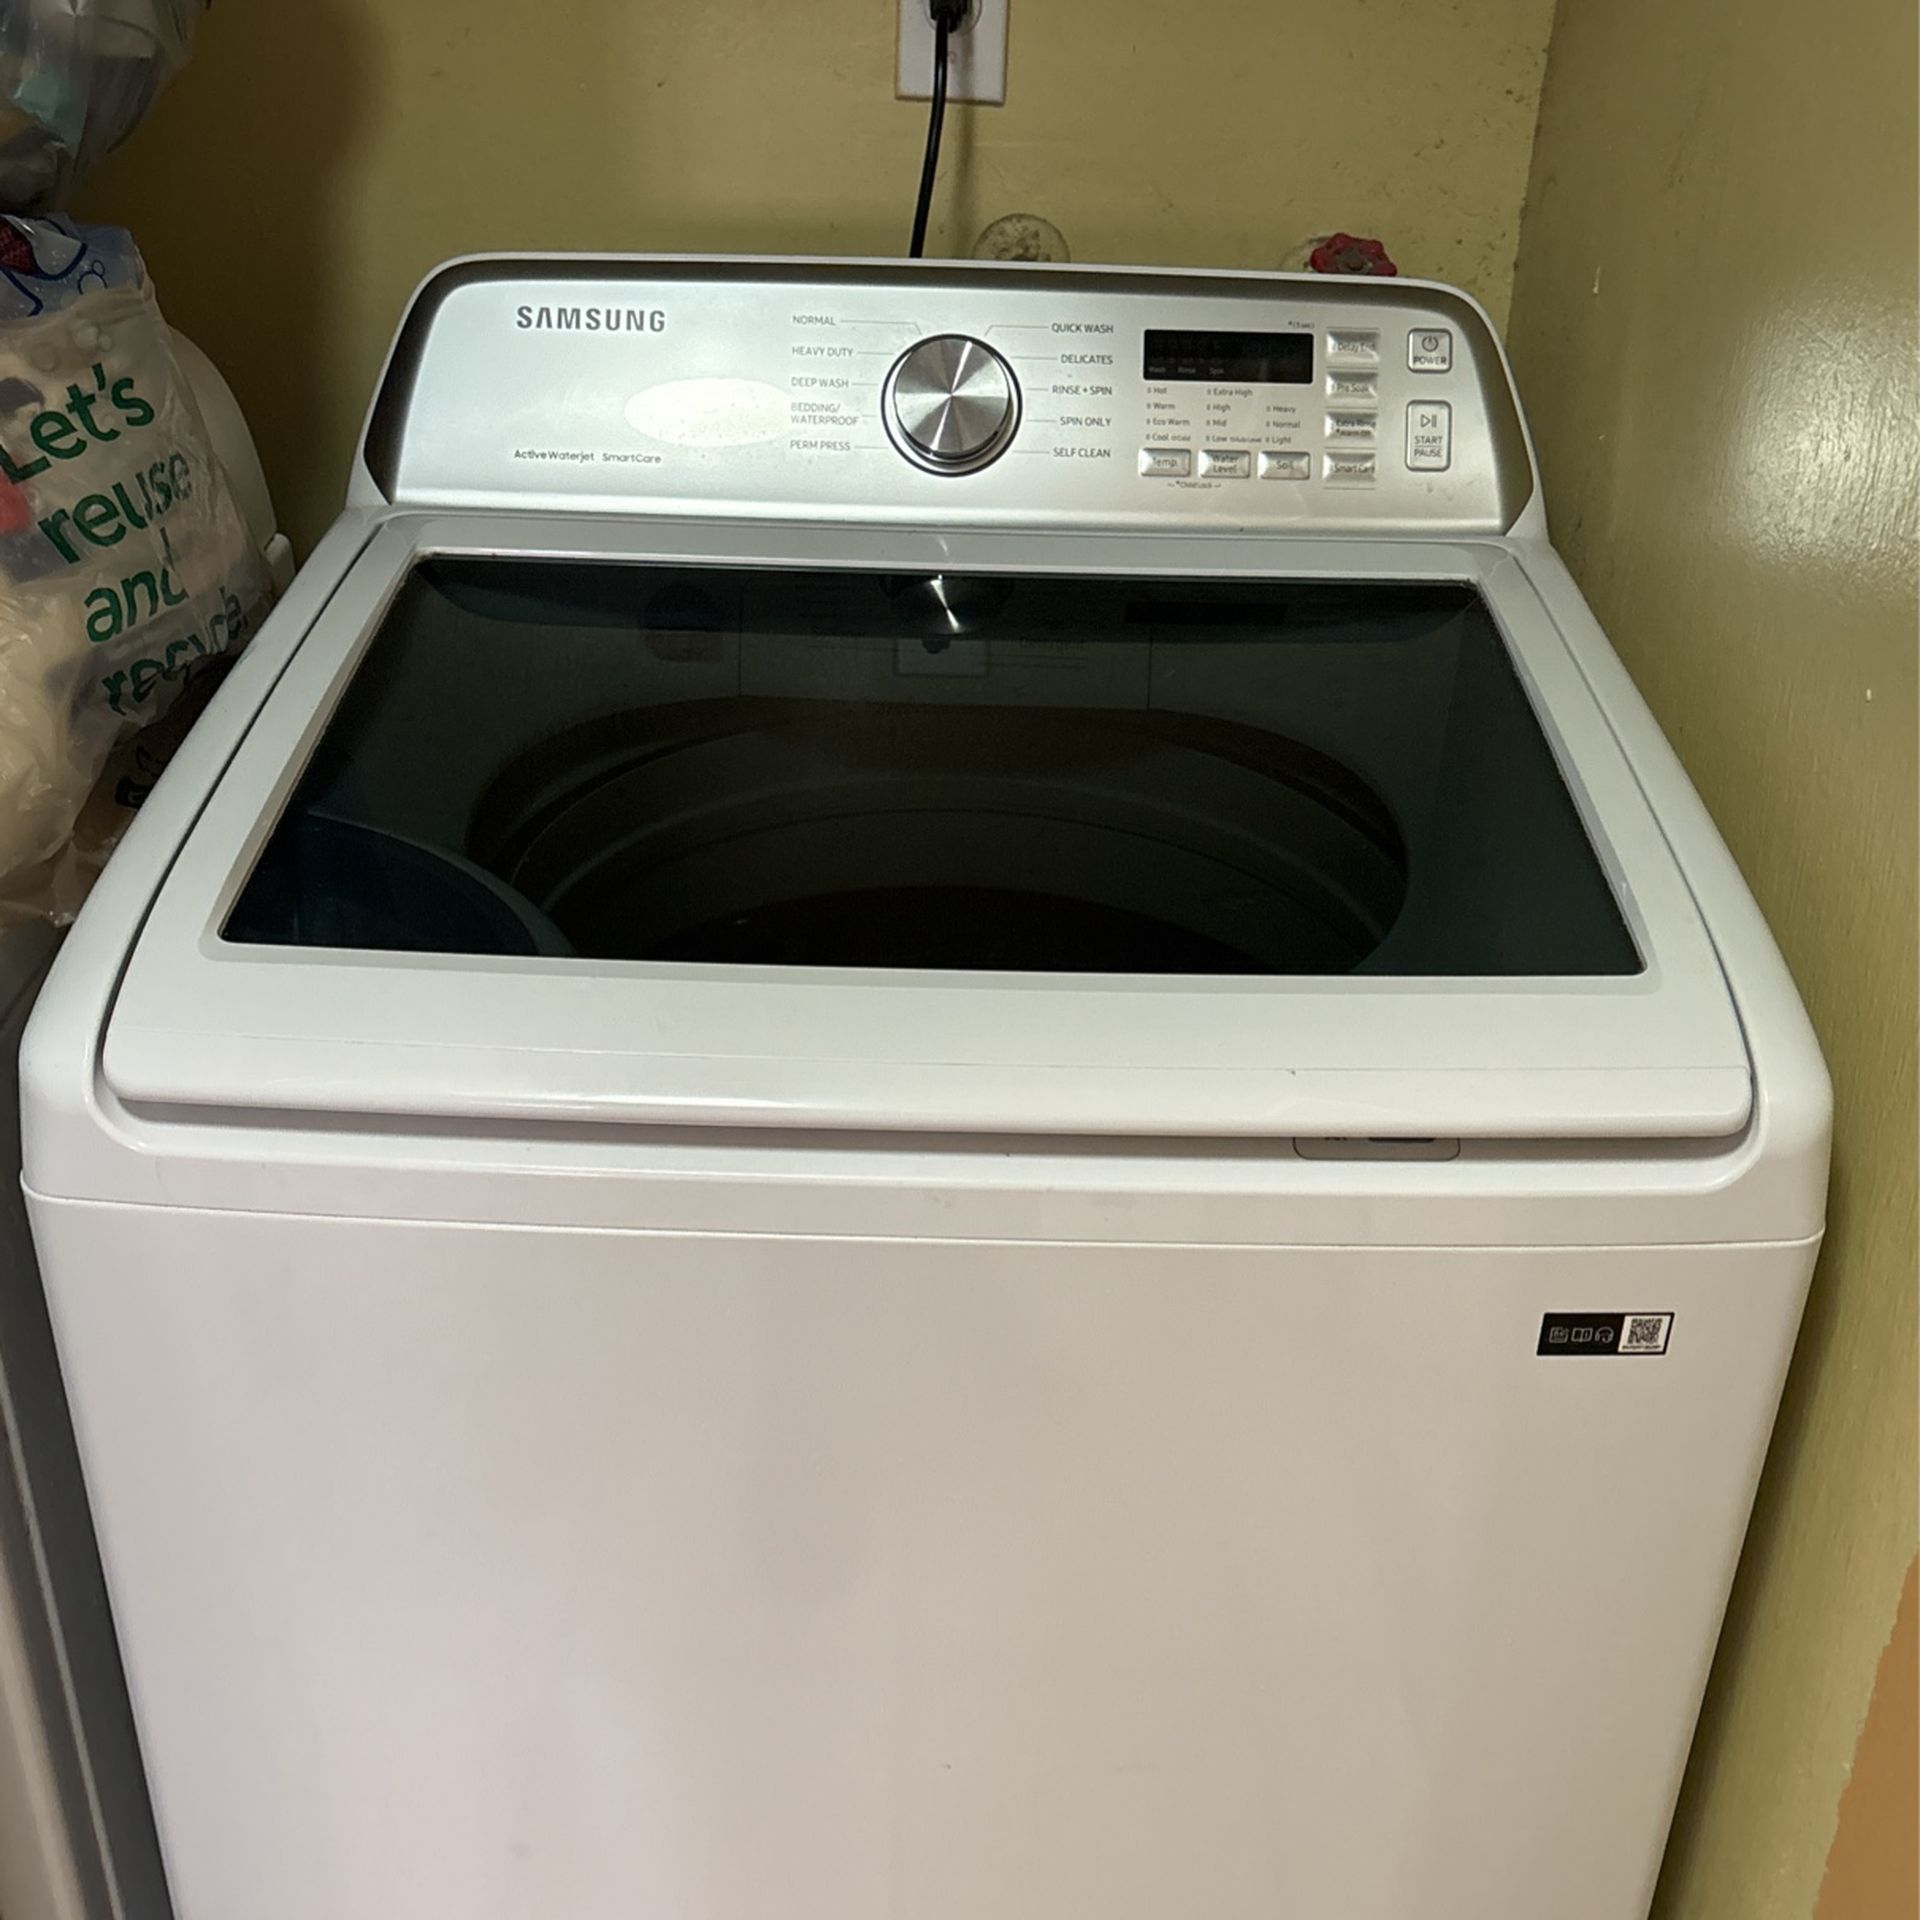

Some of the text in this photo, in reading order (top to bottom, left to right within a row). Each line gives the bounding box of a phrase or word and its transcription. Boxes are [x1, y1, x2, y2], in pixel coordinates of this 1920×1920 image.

[516, 305, 666, 333] SAMSUNG
[792, 315, 836, 327] NORMAL
[1051, 322, 1114, 334] QUICK WASH
[791, 346, 854, 357] HEAVY DUTY
[1060, 353, 1114, 365] DELICATES
[1412, 356, 1448, 365] POWER
[791, 376, 849, 388] DEEP WASH
[1052, 384, 1081, 395] RINSE
[1089, 385, 1113, 396] SPIN
[1153, 387, 1168, 395] Hot
[1213, 387, 1253, 399] Extra High
[791, 402, 841, 413] BEDDING/
[1212, 403, 1232, 413] High
[1272, 405, 1297, 414] Heavy
[0, 362, 156, 486] Let's
[791, 414, 860, 426] WATERPROOF
[1060, 416, 1111, 427] SPIN ONLY
[1168, 419, 1191, 427] Warm
[1212, 419, 1228, 428] Mid
[1272, 420, 1301, 429] Normal
[790, 439, 852, 452] PERM PRESS
[1271, 436, 1293, 446] Light
[1414, 435, 1443, 445] START
[1053, 447, 1112, 458] SELF CLEAN
[1413, 448, 1442, 458] PAUSE
[1212, 454, 1240, 464] Water
[1212, 464, 1238, 474] Level
[1276, 460, 1295, 470] Soil
[38, 453, 191, 563] reuse
